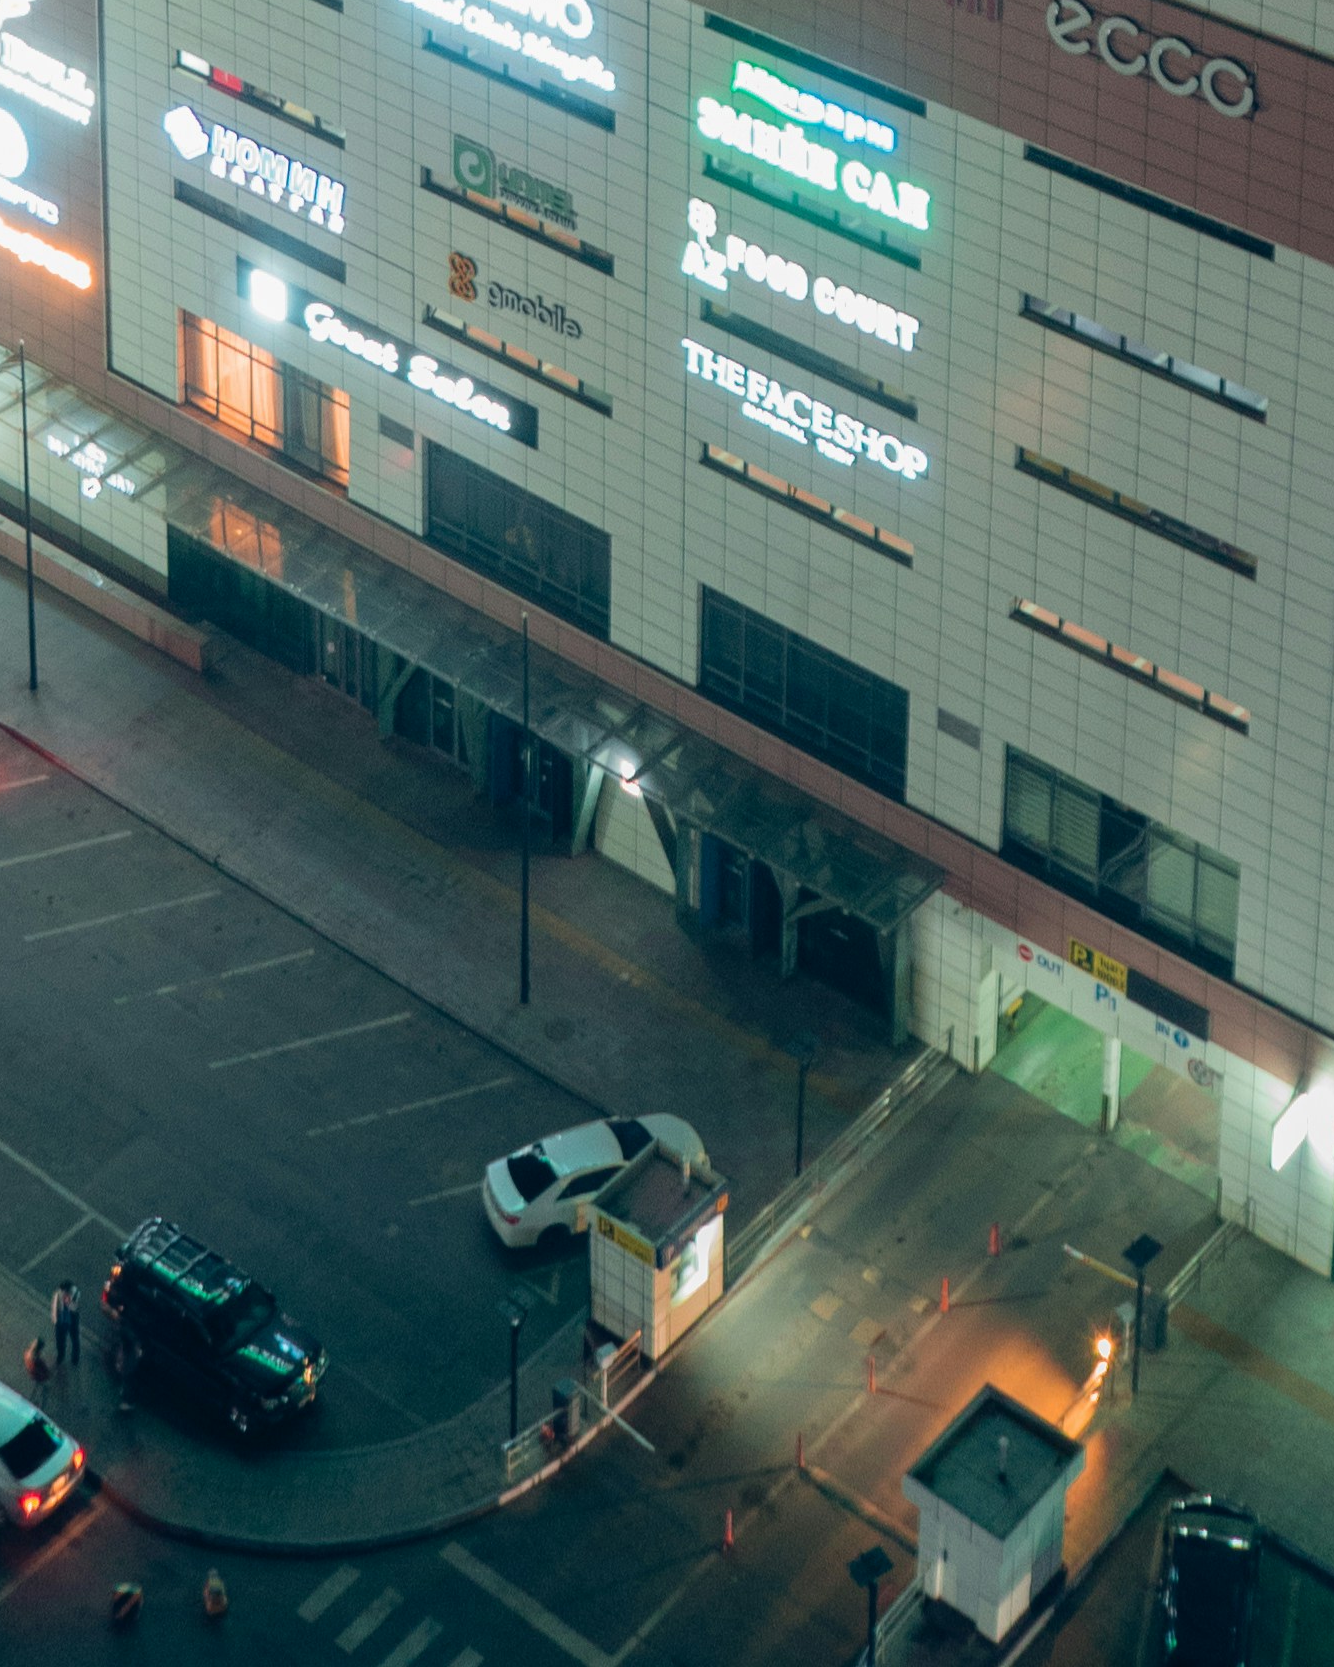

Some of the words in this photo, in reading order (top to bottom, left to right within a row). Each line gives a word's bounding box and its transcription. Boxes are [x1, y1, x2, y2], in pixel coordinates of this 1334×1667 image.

[211, 123, 346, 215] НОМИН
[488, 280, 583, 340] gmobile
[726, 234, 809, 302] FOOD
[813, 277, 920, 353] COURT
[407, 354, 511, 431] Salon
[1037, 954, 1062, 976] OUT
